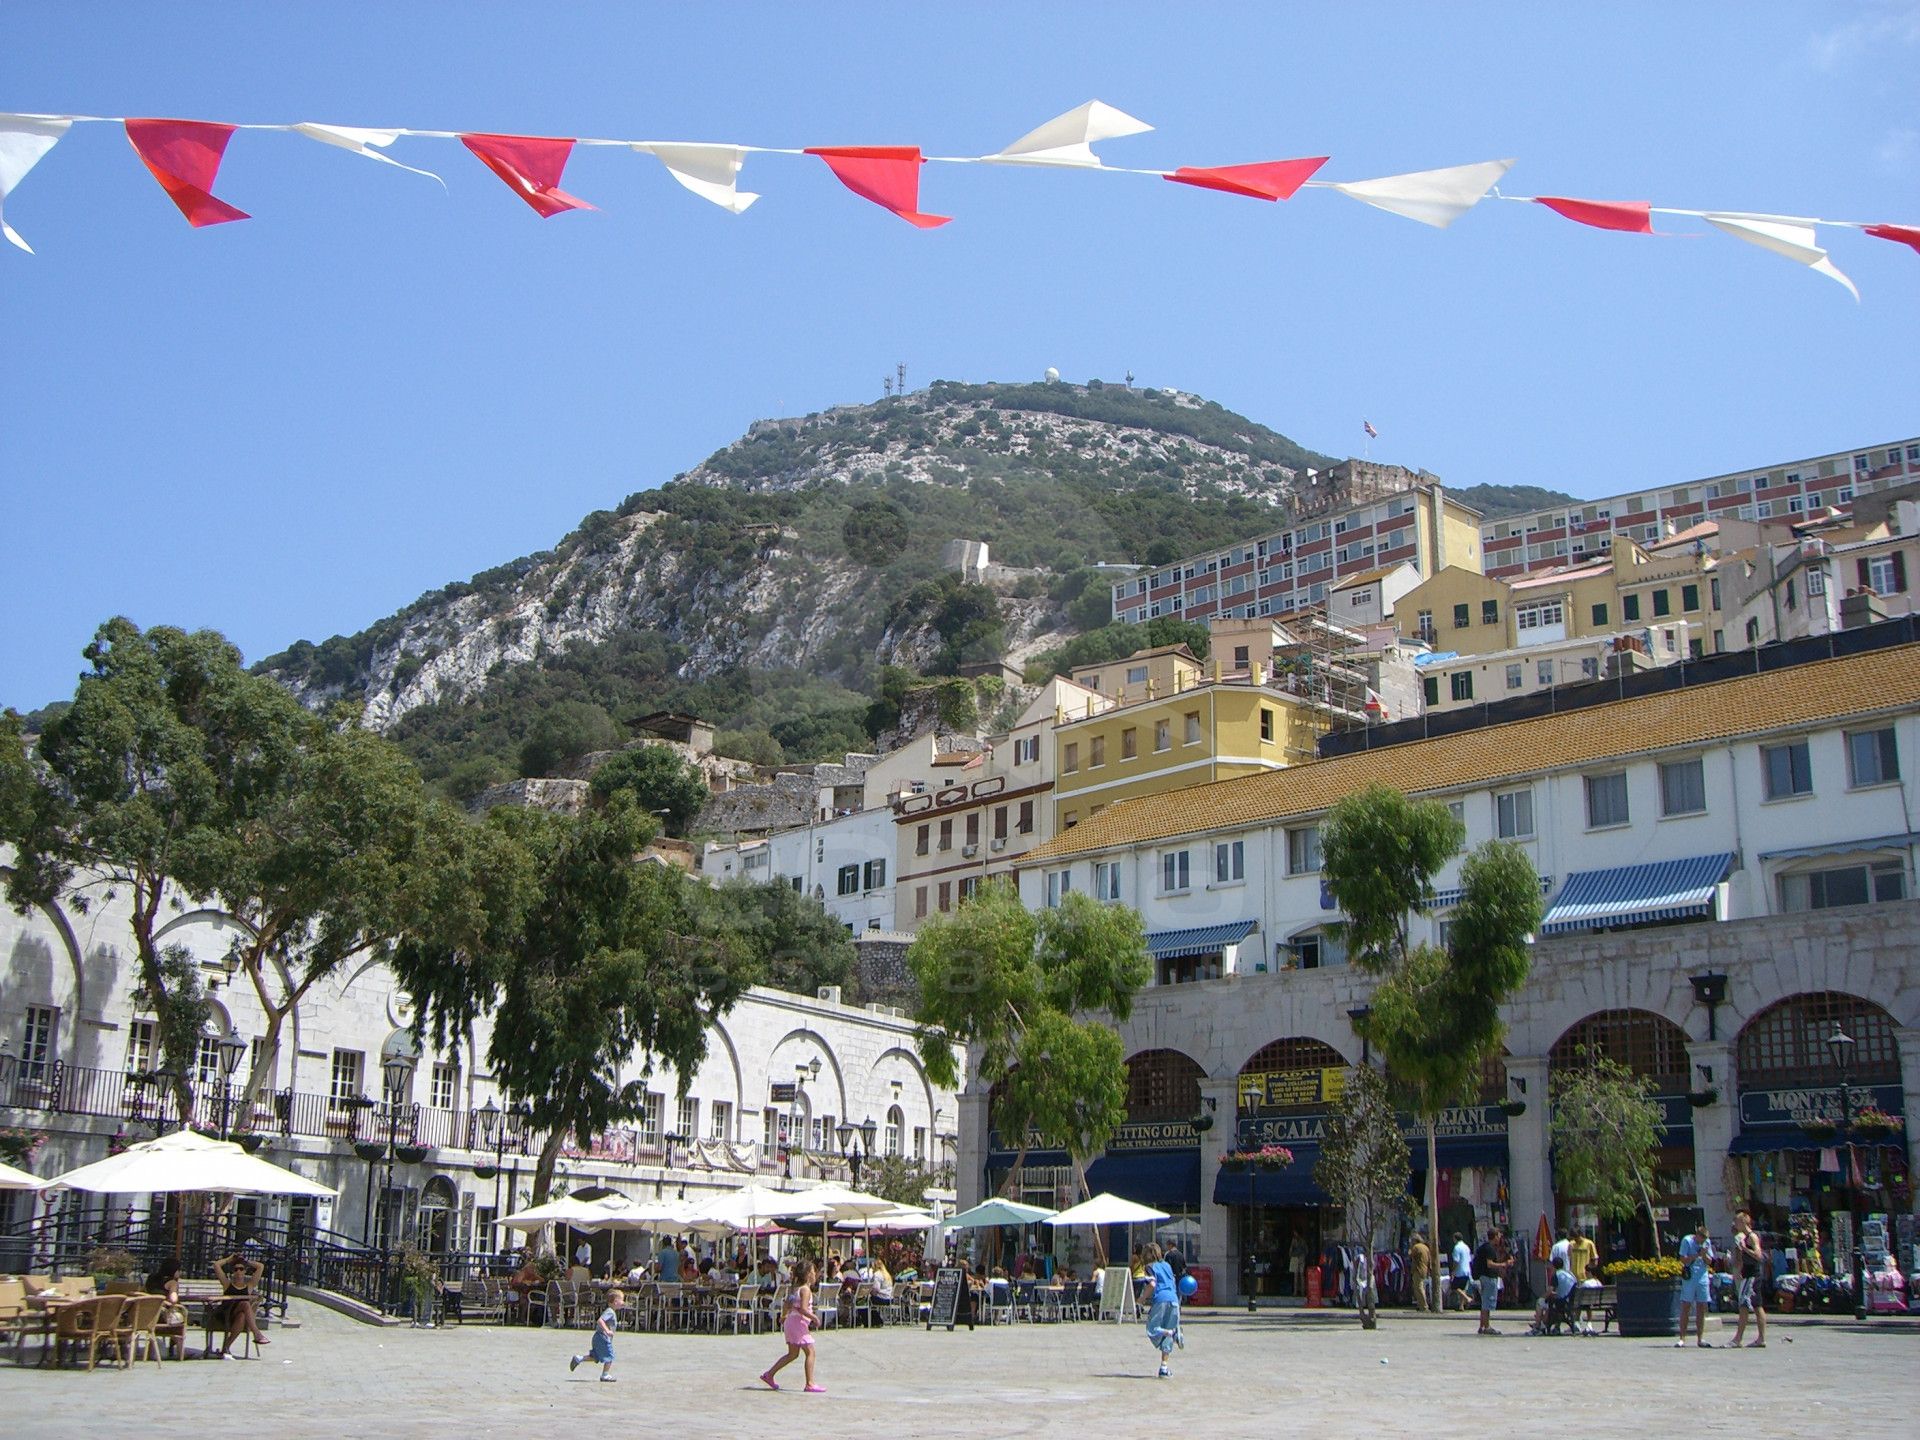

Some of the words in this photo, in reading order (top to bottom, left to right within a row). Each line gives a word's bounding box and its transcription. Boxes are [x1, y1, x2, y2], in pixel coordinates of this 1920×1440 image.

[1268, 1071, 1320, 1079] NADAL
[1413, 1107, 1487, 1127] MRJANI
[1263, 1120, 1327, 1140] SCALA
[1435, 1125, 1463, 1135] GIFTS
[1152, 1138, 1199, 1147] ACCOUNTANTS
